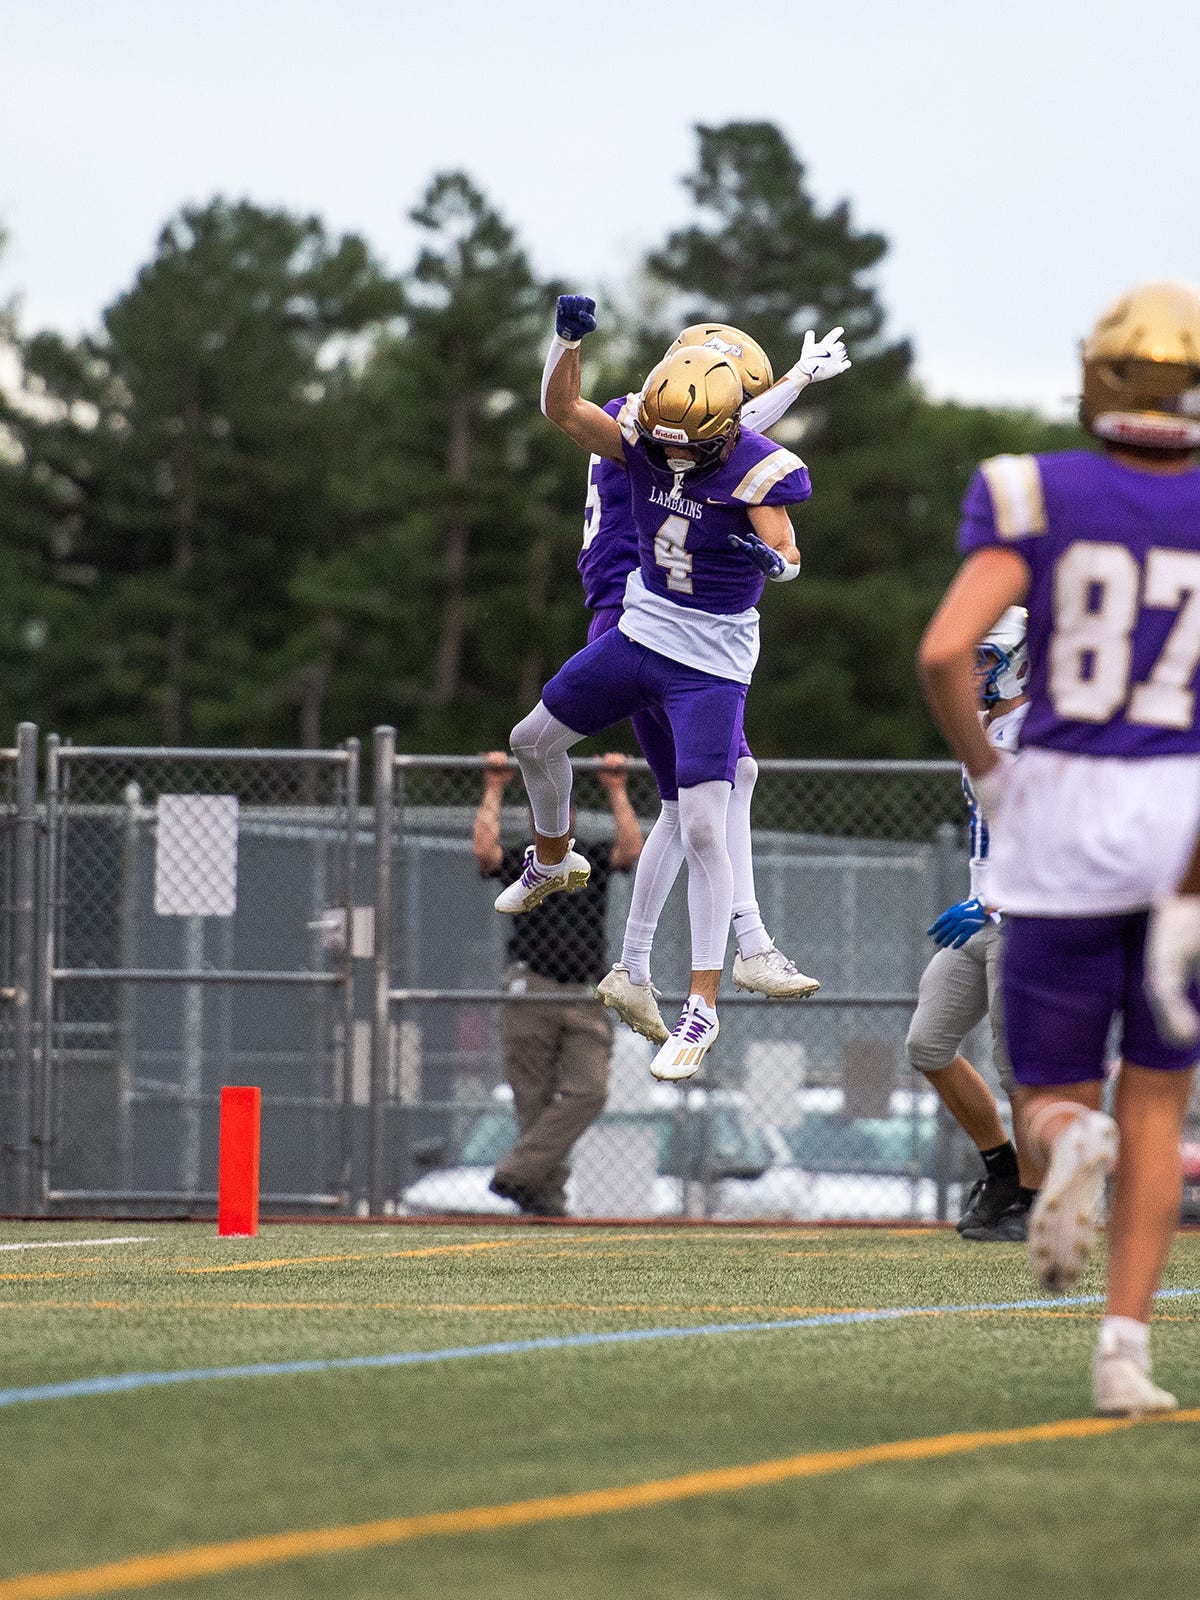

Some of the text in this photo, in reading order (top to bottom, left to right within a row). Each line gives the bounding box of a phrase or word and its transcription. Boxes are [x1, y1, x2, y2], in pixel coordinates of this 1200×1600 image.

[655, 428, 684, 440] Riddell
[648, 486, 703, 519] LAMBKINS
[654, 514, 694, 595] 4
